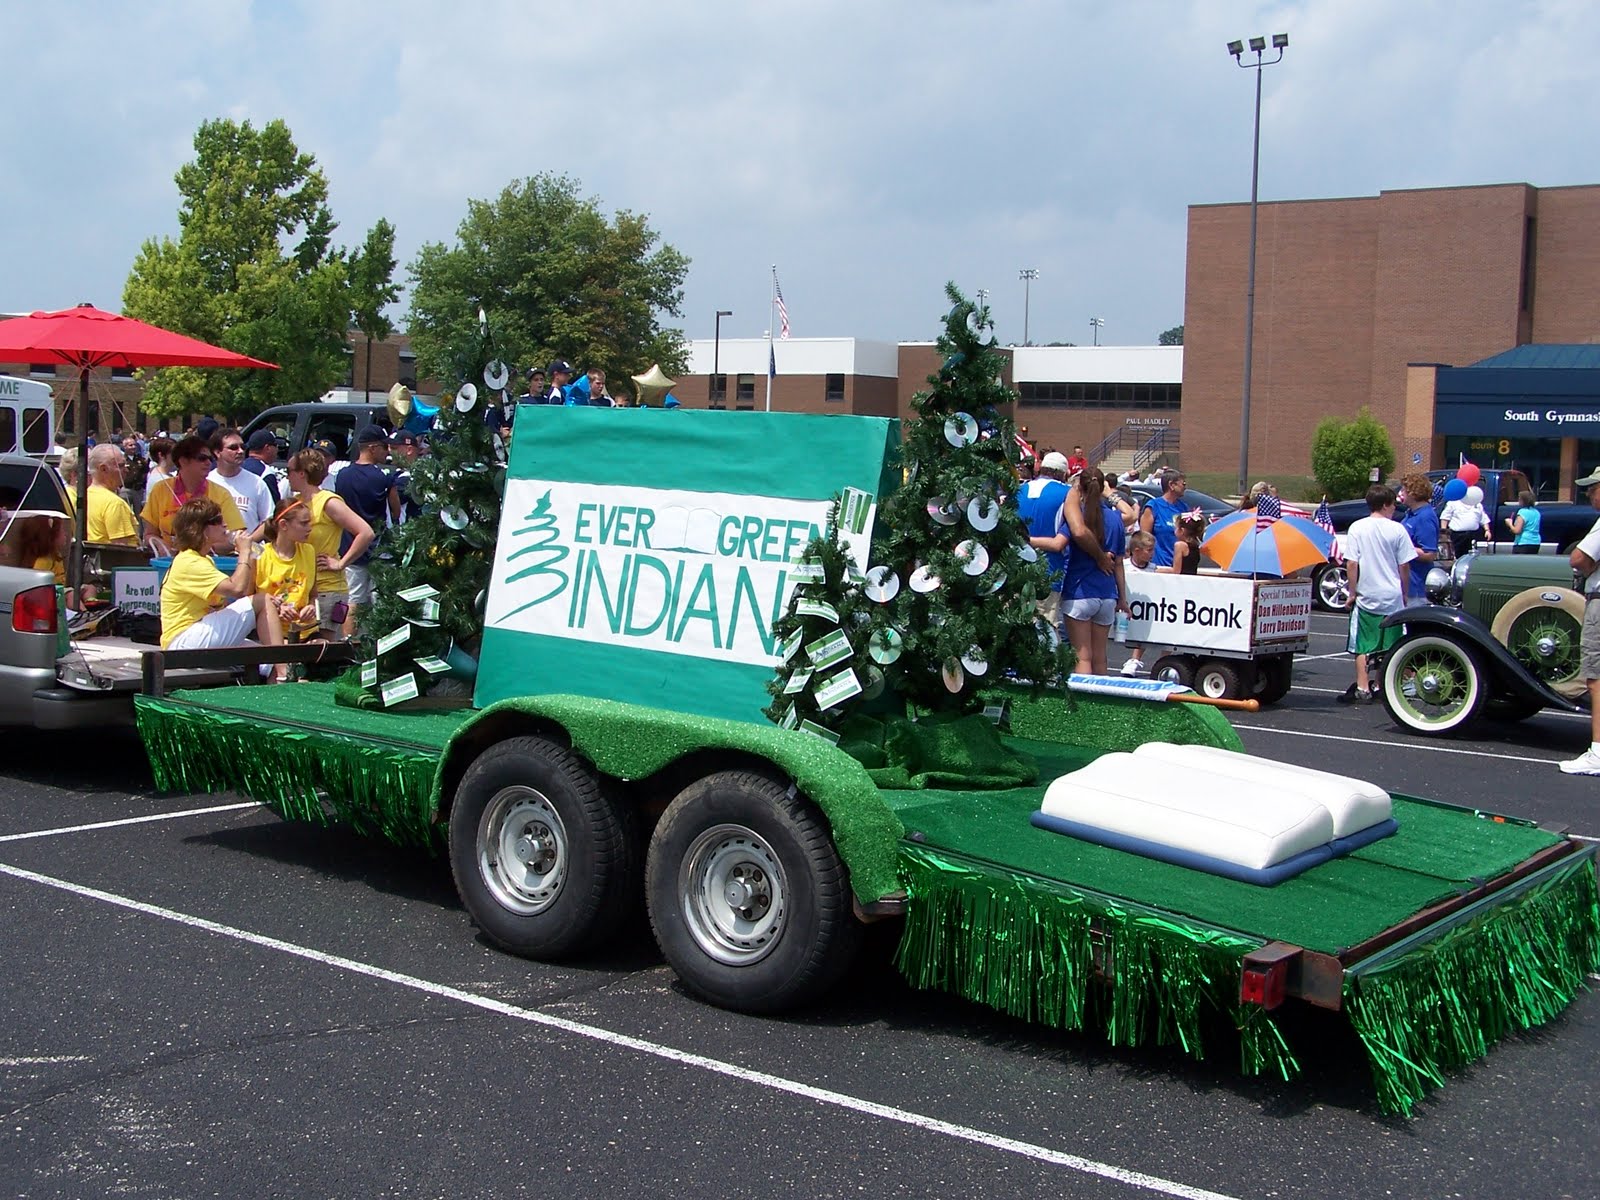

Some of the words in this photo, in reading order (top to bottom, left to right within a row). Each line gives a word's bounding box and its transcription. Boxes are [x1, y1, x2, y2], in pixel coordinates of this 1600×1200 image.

[1125, 417, 1141, 425] PAUL
[1144, 417, 1171, 425] HADLEY
[1504, 409, 1540, 421] South
[1471, 442, 1495, 450] SOUTH
[1498, 439, 1510, 455] 8
[574, 503, 656, 549] EVER
[567, 549, 784, 656] INDIAN
[1260, 589, 1280, 602] Special
[1281, 589, 1300, 599] Thanks
[1183, 599, 1242, 630] Bank
[1258, 605, 1271, 617] Dan
[1259, 621, 1276, 634] Larry
[1277, 619, 1306, 632] Davidson
